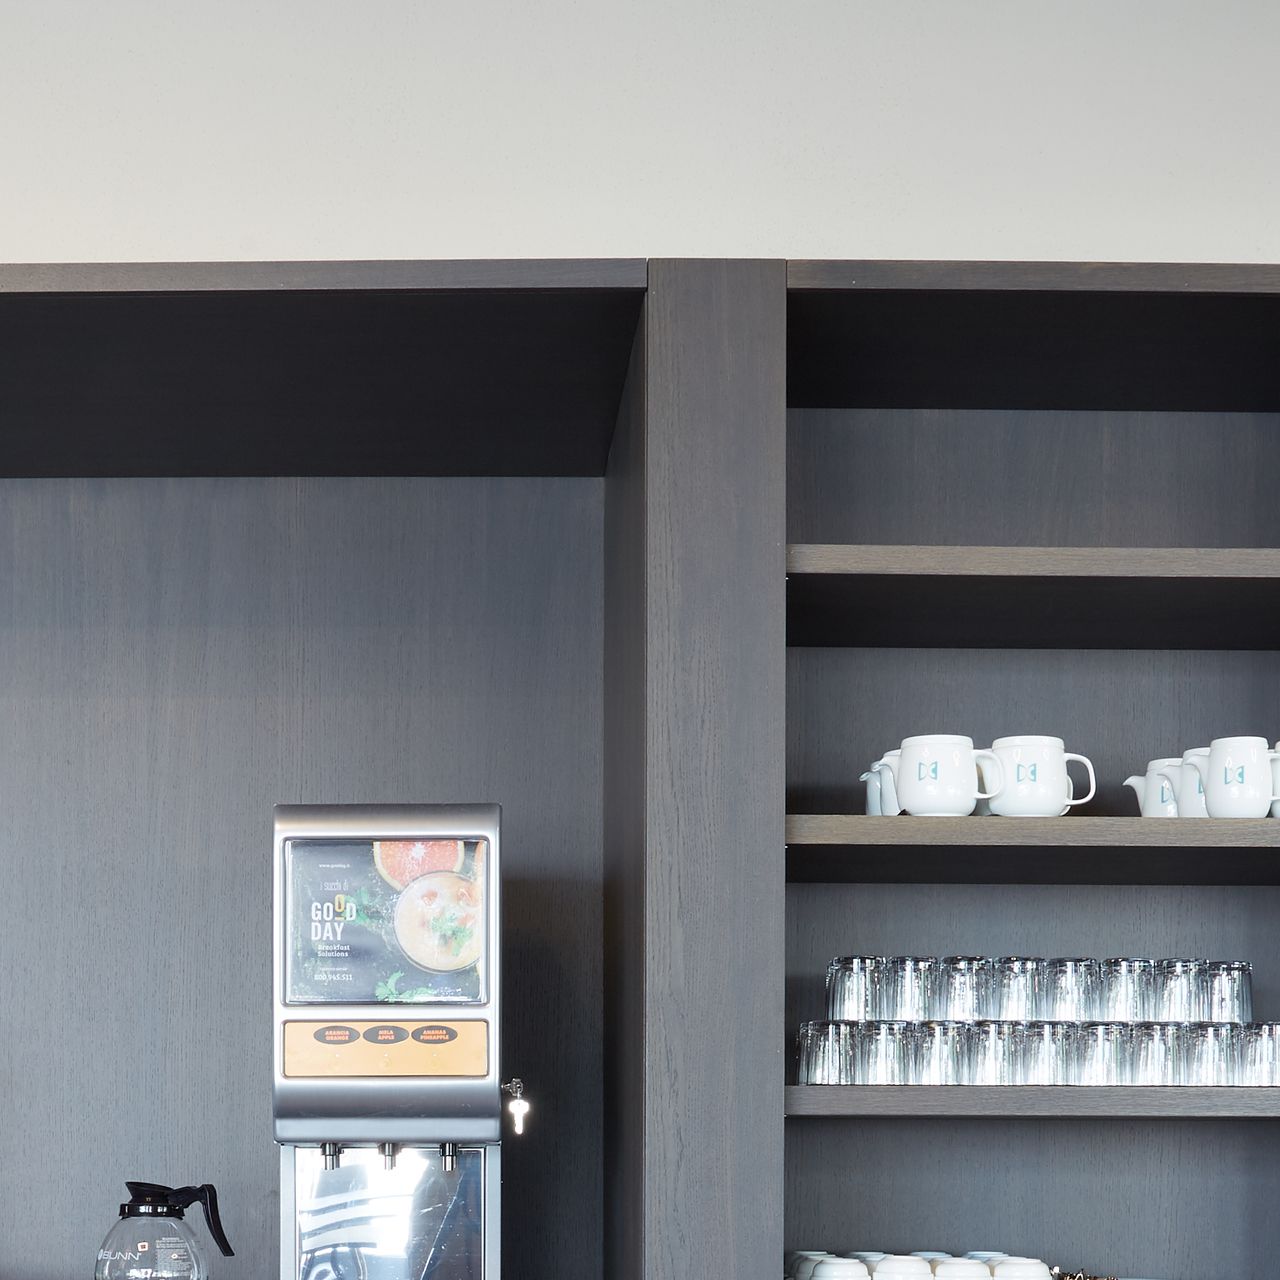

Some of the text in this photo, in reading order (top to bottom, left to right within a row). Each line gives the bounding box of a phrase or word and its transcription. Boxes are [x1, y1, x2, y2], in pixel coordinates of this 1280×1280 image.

[311, 894, 356, 920] GOOD
[311, 922, 344, 941] DAY
[103, 1250, 140, 1261] BUNN
